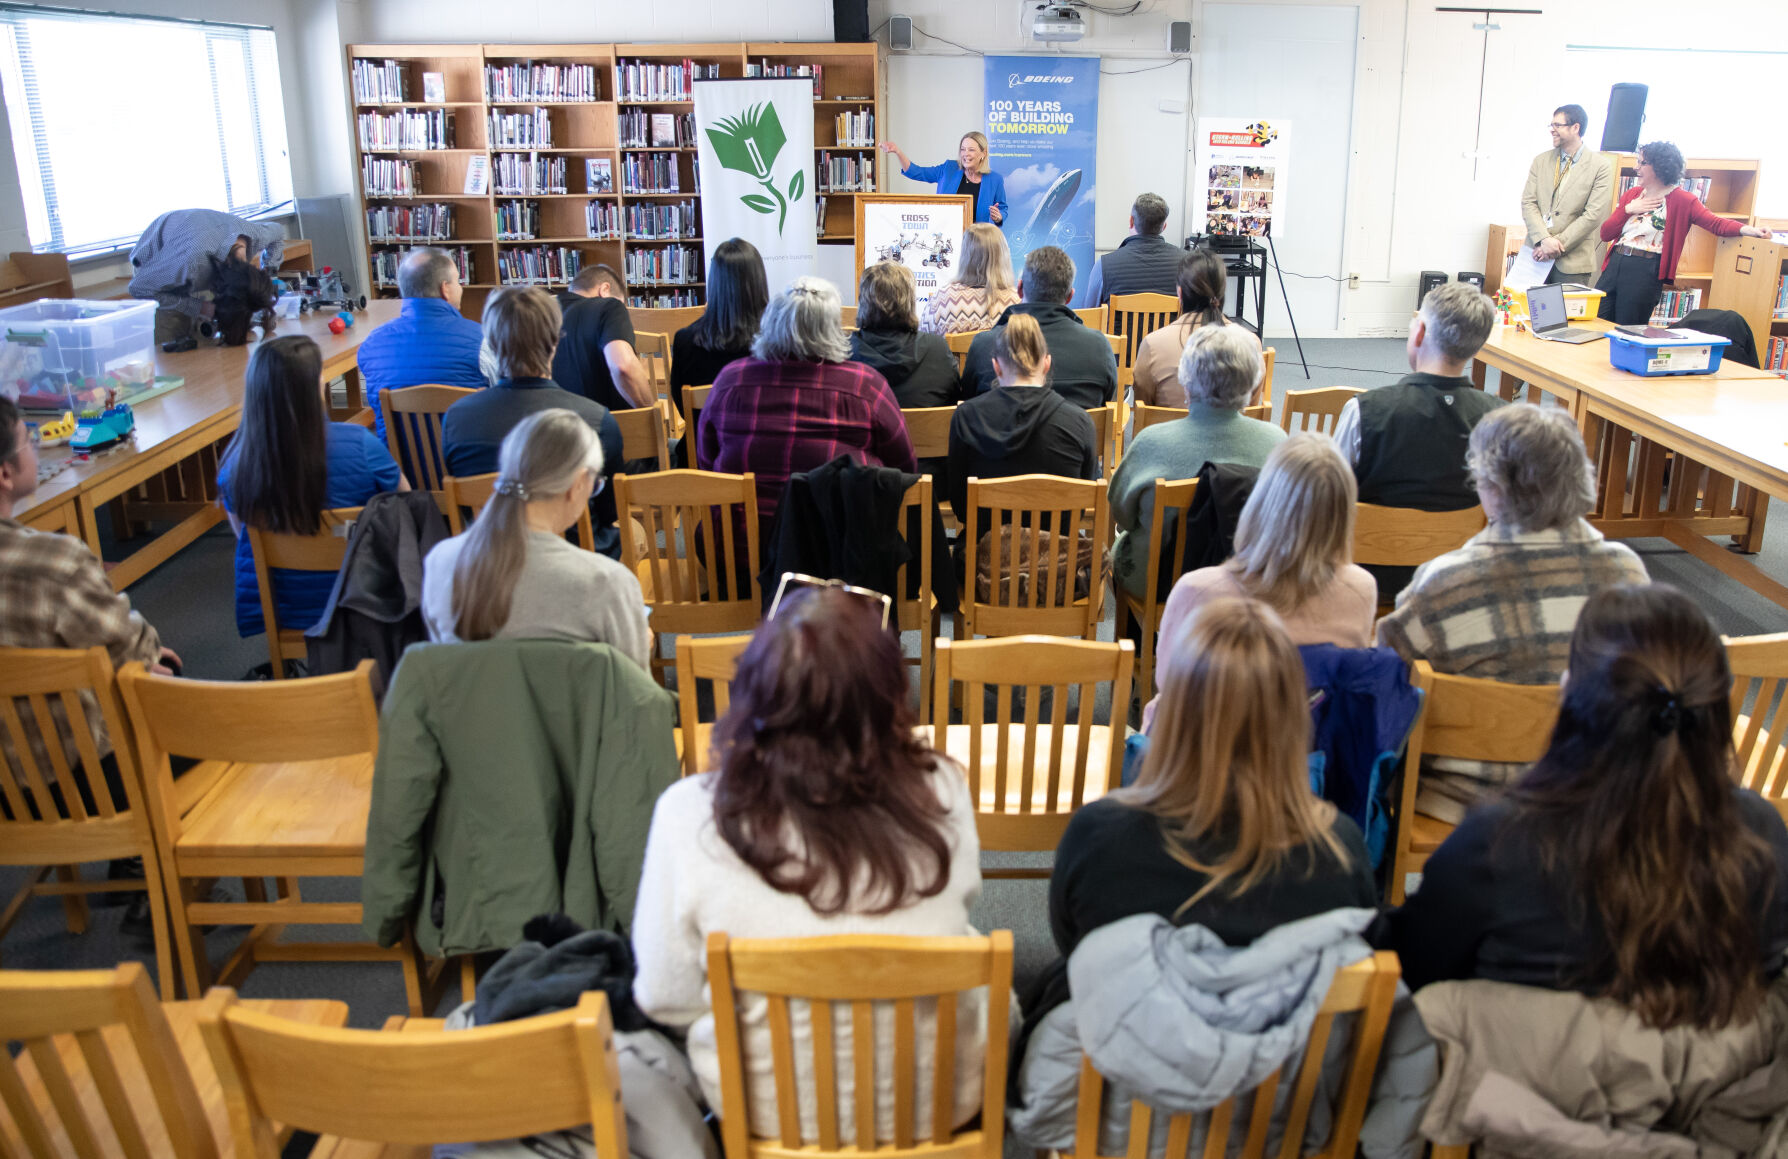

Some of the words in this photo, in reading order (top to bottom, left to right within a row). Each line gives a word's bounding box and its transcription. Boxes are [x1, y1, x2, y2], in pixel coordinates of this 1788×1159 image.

[1024, 75, 1074, 83] BOEING
[989, 100, 1013, 111] 100
[1016, 101, 1062, 112] YEARS
[988, 111, 1007, 122] OF
[1010, 112, 1074, 123] BUILDING
[988, 123, 1069, 134] TOMORROW
[901, 214, 930, 222] CROSS
